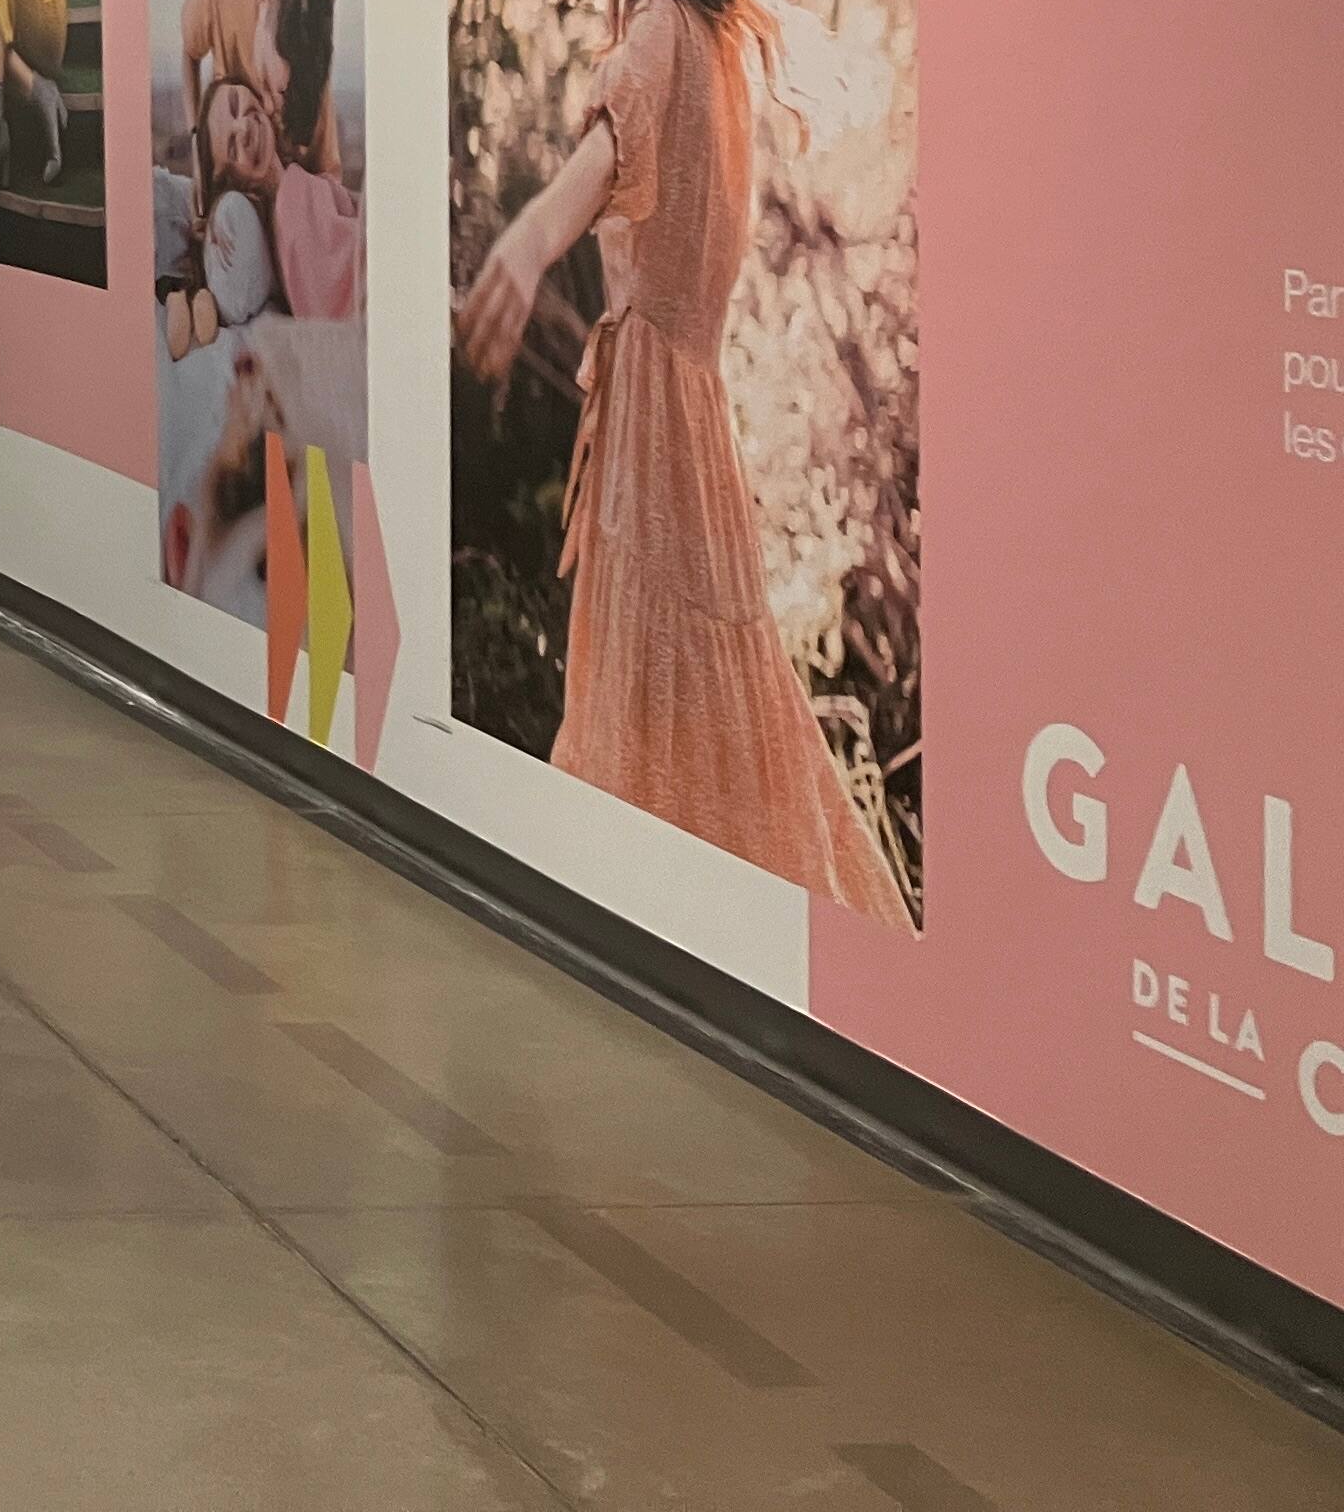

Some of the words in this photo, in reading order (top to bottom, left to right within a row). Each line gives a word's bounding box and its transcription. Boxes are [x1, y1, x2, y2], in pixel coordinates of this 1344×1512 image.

[1283, 410, 1336, 462] les
[1022, 723, 1335, 982] GAL
[1132, 958, 1191, 1027] DE
[1208, 990, 1265, 1062] LA
